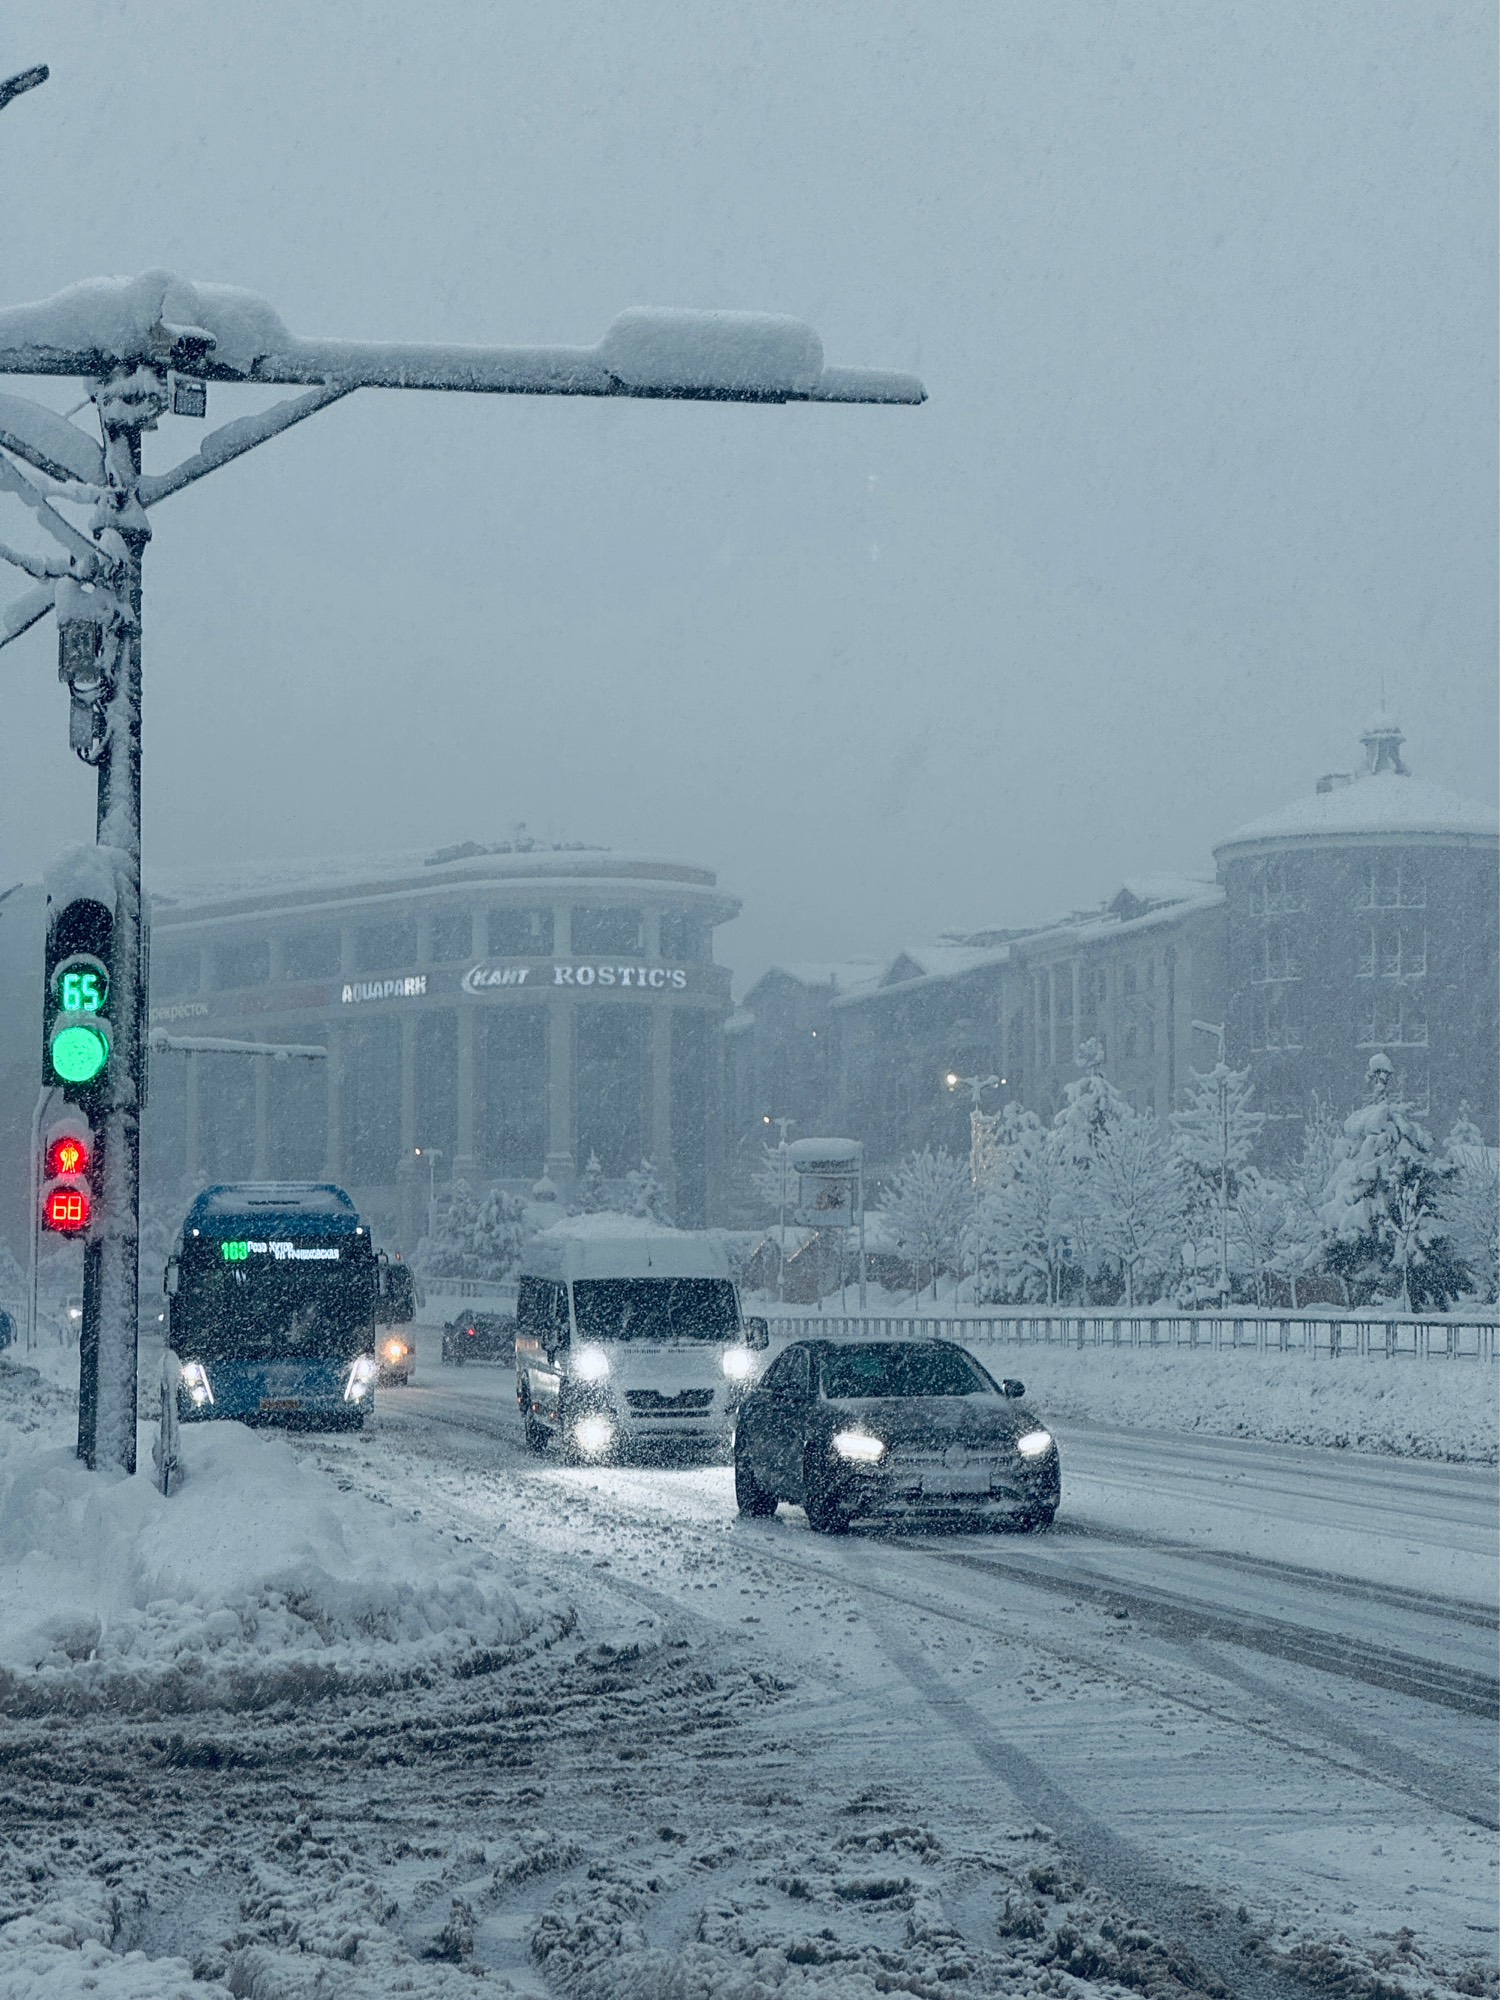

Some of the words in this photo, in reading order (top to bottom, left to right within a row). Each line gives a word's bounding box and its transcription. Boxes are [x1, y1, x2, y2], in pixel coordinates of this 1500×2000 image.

[342, 975, 427, 1003] AQUAPARK
[553, 965, 687, 989] ROSTIC'S
[64, 973, 99, 1011] 65
[53, 1195, 82, 1221] 68
